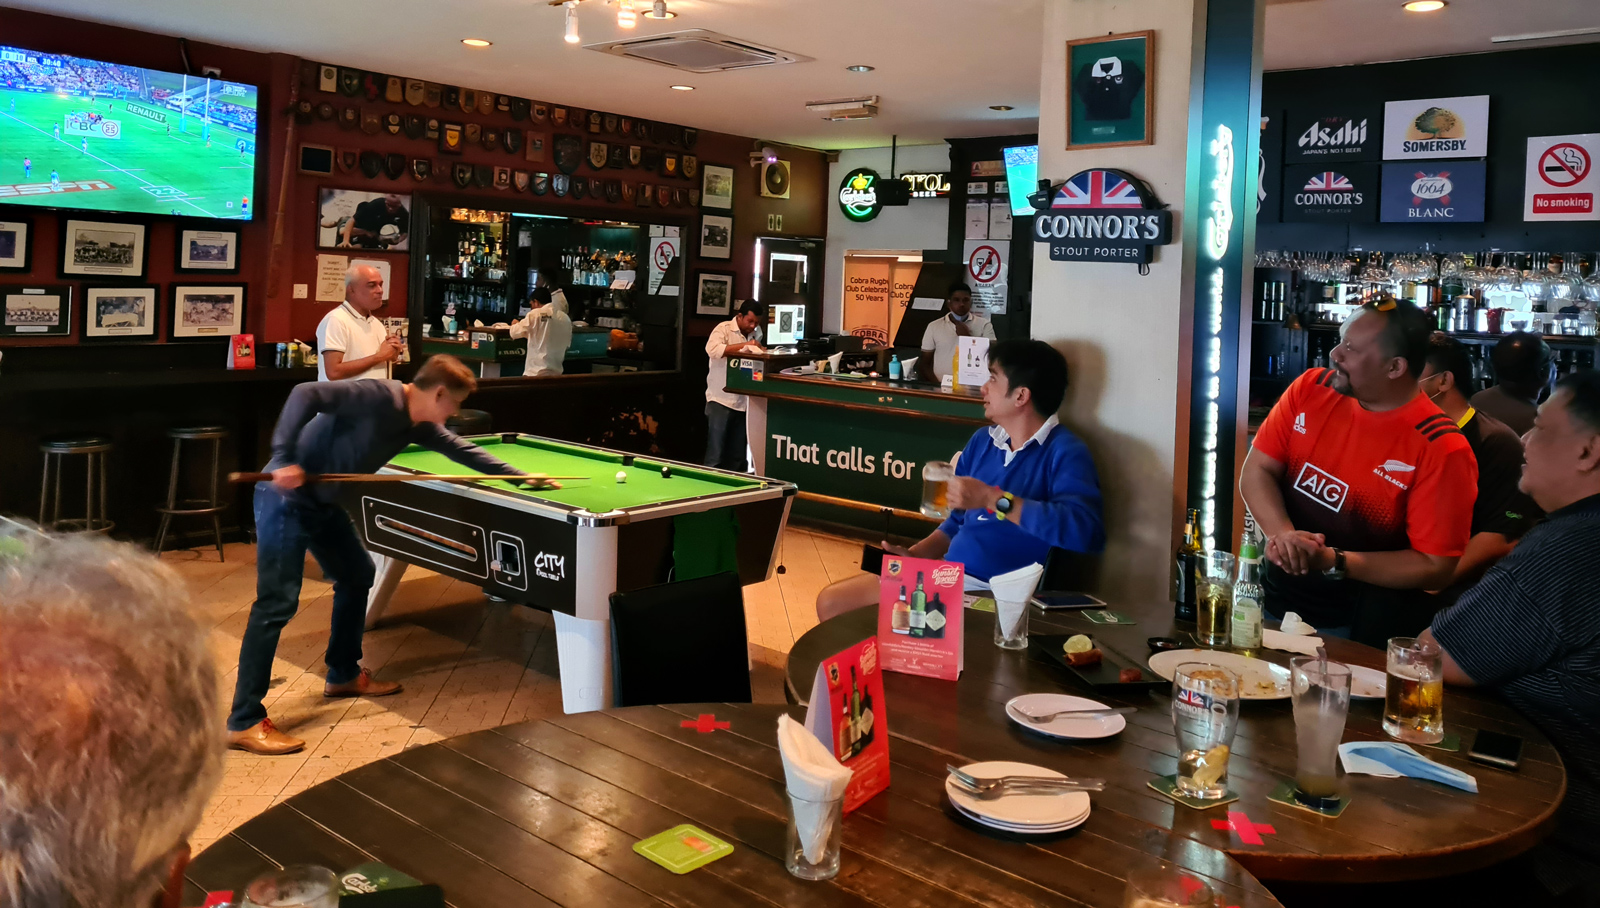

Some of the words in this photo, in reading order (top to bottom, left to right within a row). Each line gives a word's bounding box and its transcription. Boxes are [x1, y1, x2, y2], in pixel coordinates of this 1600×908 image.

[127, 103, 166, 122] RENAULT
[1298, 119, 1367, 148] Asahi
[1402, 139, 1467, 153] SOMERSBY
[1416, 181, 1446, 195] 1664
[1294, 192, 1363, 206] CONNOR'S
[1536, 198, 1549, 207] No
[1550, 197, 1590, 209] smoking
[1408, 206, 1454, 218] BLANC
[1035, 214, 1160, 240] CONNOR'S
[1053, 247, 1088, 256] STOUT
[1093, 248, 1139, 258] PORTER
[850, 276, 869, 284] Cobra
[894, 282, 914, 291] Cobra
[855, 293, 865, 301] 50
[866, 294, 884, 302] Years
[772, 434, 820, 465] That
[826, 446, 875, 474] calls
[882, 451, 916, 480] for
[1372, 468, 1384, 477] ALL
[1384, 475, 1408, 491] BLACKS
[1301, 474, 1342, 503] AIG
[534, 551, 565, 579] CITY
[1174, 699, 1210, 717] CONNOR'S
